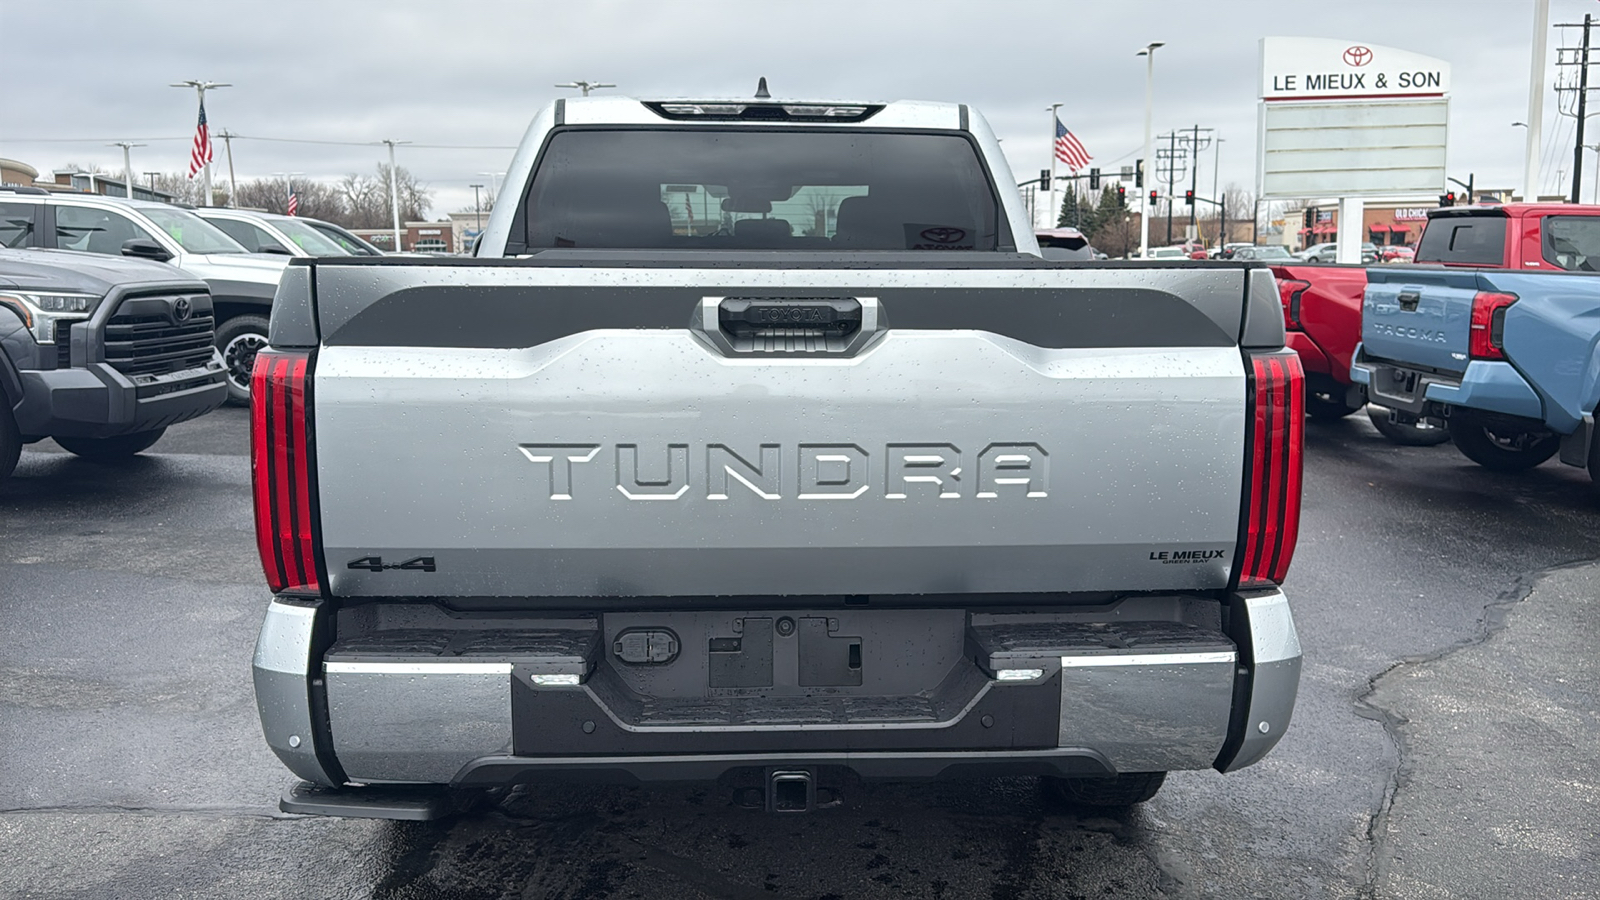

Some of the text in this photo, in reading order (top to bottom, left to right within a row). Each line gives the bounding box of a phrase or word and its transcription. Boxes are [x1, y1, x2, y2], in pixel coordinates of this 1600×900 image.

[1274, 71, 1441, 91] LE MIEUX & SON
[1395, 207, 1430, 219] OLD CHICA
[758, 307, 823, 321] TOYOTA
[1373, 322, 1447, 344] TACOMA
[517, 441, 1050, 502] TUNDRA
[1149, 549, 1225, 560] LE MIEUX
